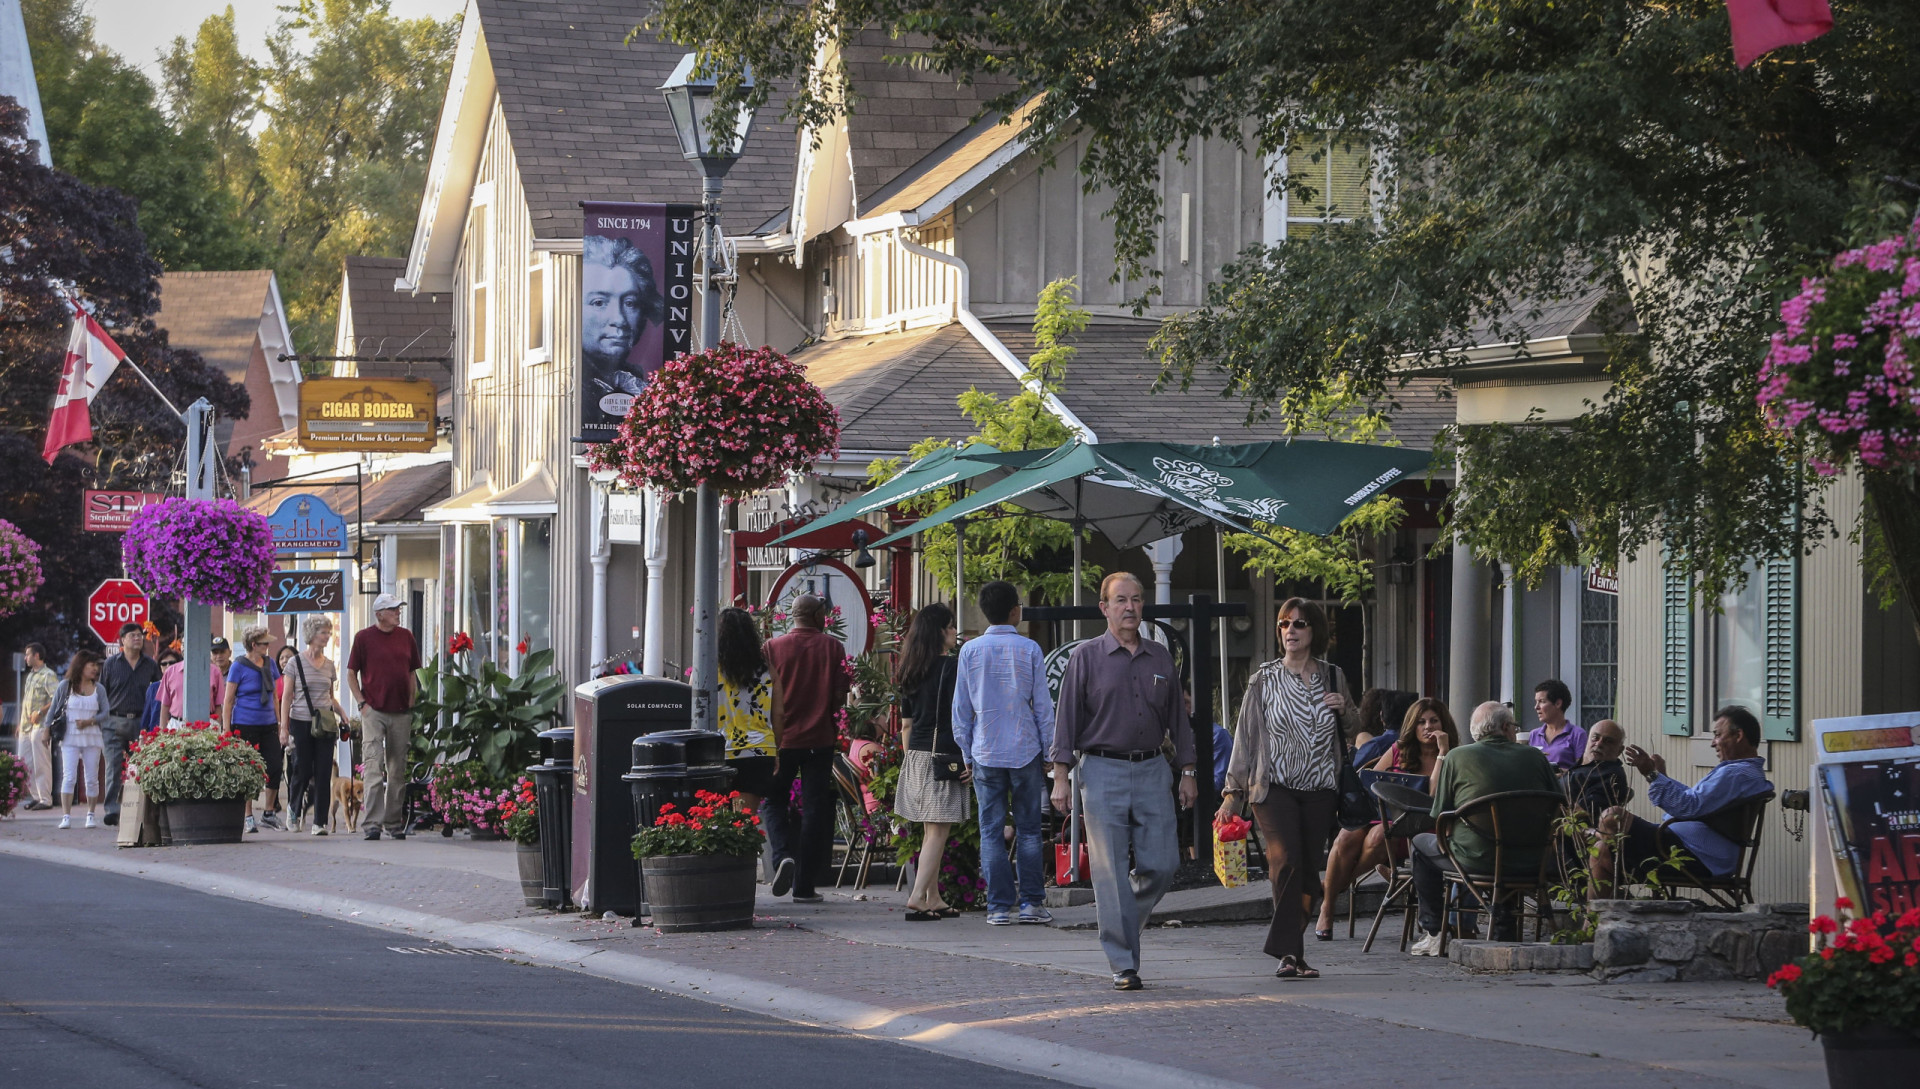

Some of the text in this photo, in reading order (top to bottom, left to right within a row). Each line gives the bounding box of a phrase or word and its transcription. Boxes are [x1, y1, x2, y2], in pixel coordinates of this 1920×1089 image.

[597, 217, 651, 230] SINCE 1794
[322, 402, 415, 418] CIGAR BODEGA
[310, 433, 340, 441] Premium
[341, 433, 355, 442] Leaf
[356, 433, 375, 442] House
[384, 434, 400, 443] Cigar
[402, 434, 425, 443] Lounge
[1343, 467, 1402, 506] STARBUCKS COFFEE
[90, 513, 120, 523] Stephen
[270, 519, 338, 539] Edible
[300, 572, 340, 585] Unionville
[270, 577, 318, 612] Spa
[94, 602, 144, 622] STOP
[1888, 815, 1920, 825] art
[1872, 884, 1920, 917] SH
